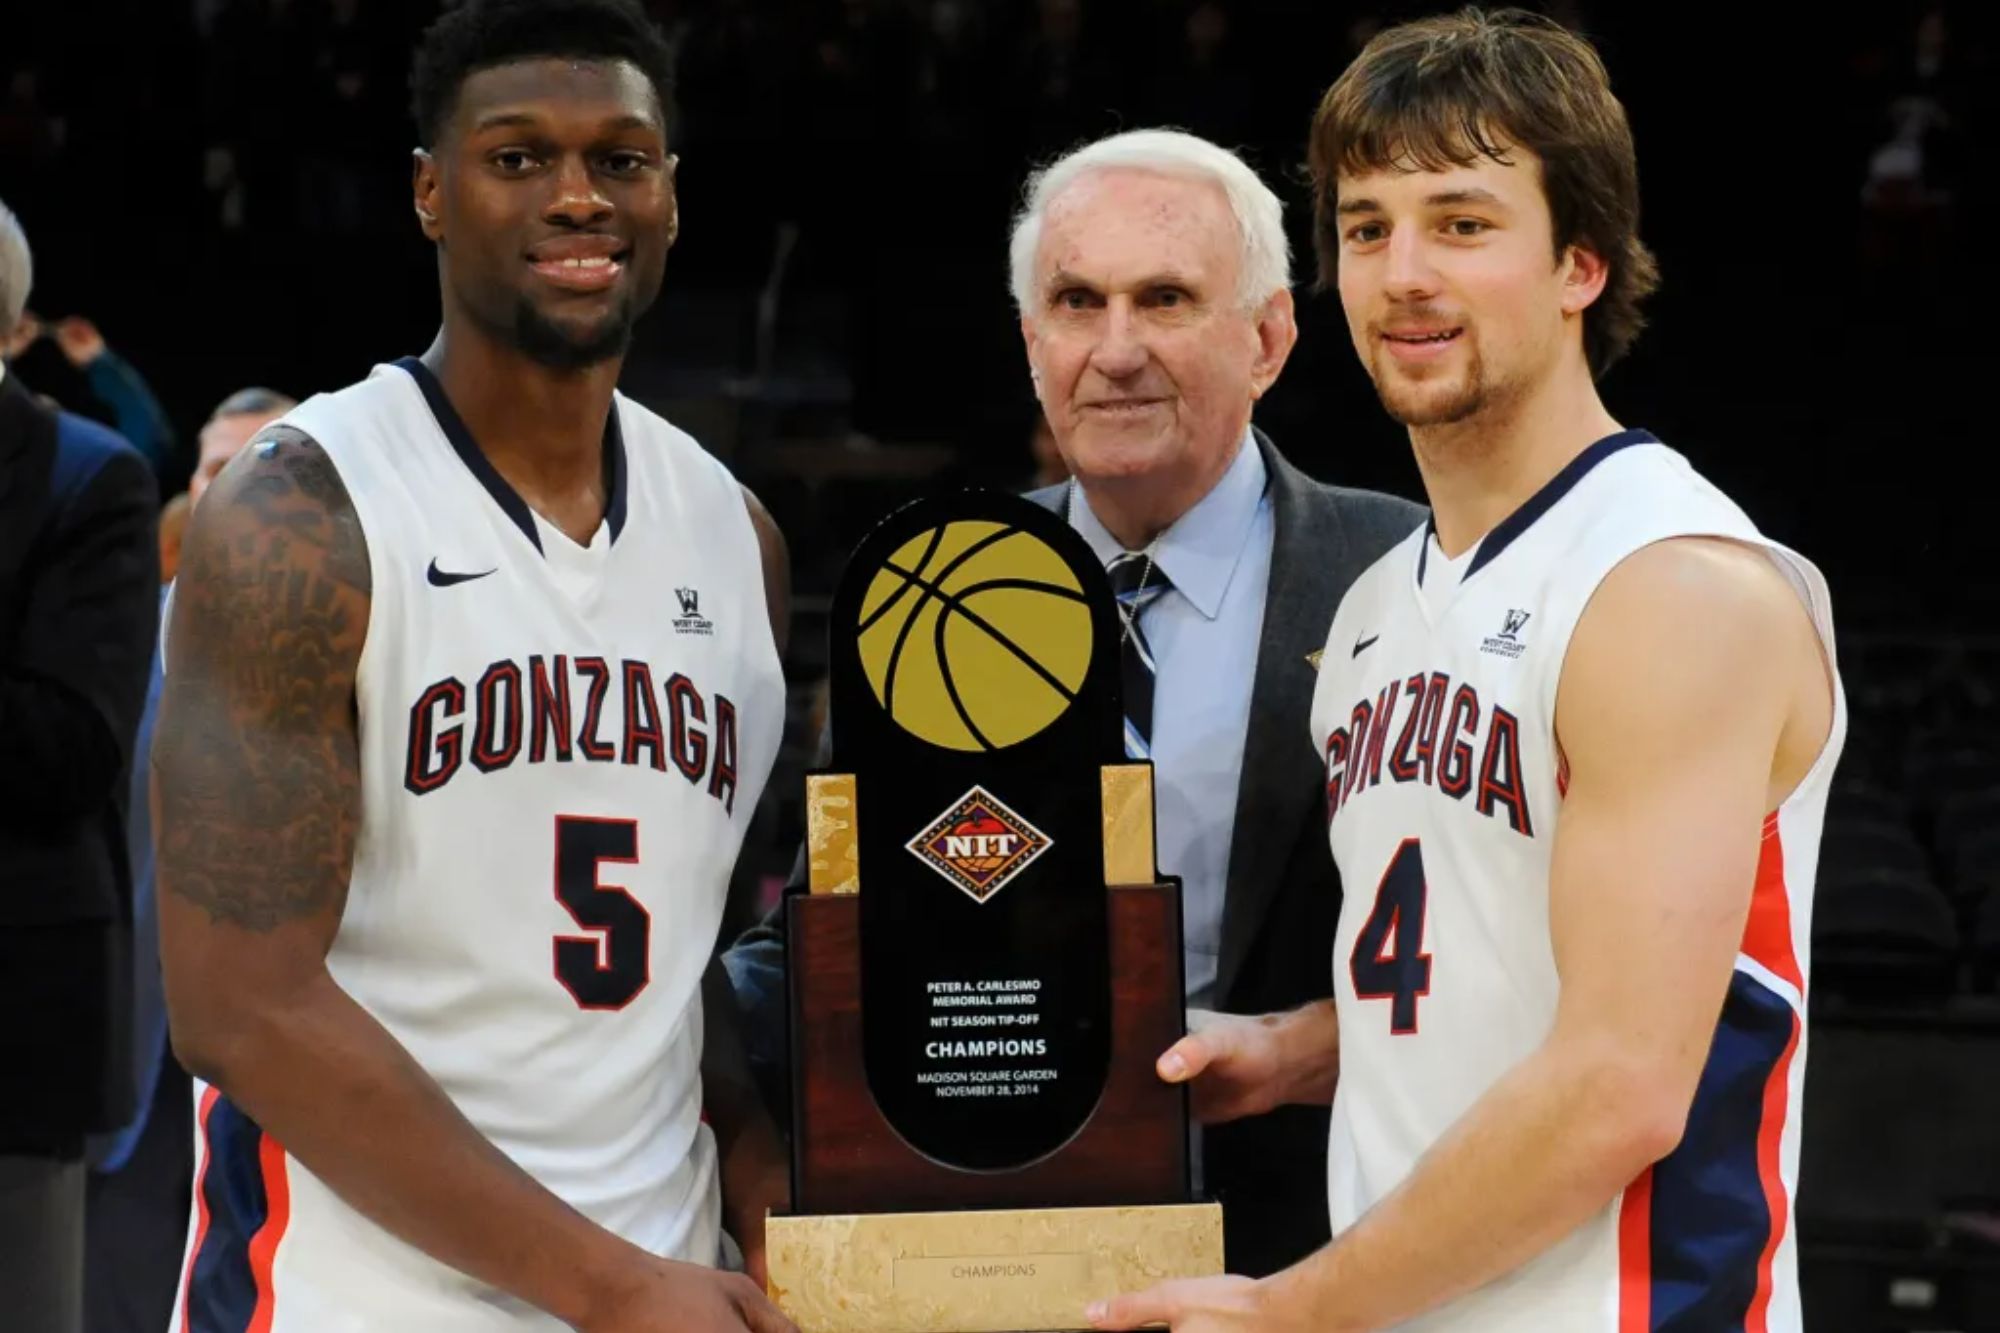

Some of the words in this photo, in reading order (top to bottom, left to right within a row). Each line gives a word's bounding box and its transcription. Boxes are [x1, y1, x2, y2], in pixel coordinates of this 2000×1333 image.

[404, 654, 738, 818] GONZAGA
[1326, 671, 1534, 838] GONZAGA
[944, 833, 1018, 859] NIT
[553, 814, 651, 1011] 5
[1350, 838, 1432, 1035] 4
[927, 982, 962, 993] PETER
[964, 981, 976, 992] A.
[976, 980, 1042, 992] CARLESIMO
[933, 996, 994, 1007] MEMORIAL
[995, 994, 1037, 1005] AWARD
[930, 1017, 949, 1028] NIT
[951, 1015, 997, 1027] SEASON
[997, 1014, 1040, 1025] TIP-OFF
[925, 1038, 1047, 1058] CHAMPIONS
[917, 1072, 968, 1083] MADISON
[969, 1070, 1011, 1083] SQUARE
[1013, 1069, 1058, 1081] GARDEN
[936, 1085, 995, 1097] NOVEMBER
[996, 1085, 1012, 1096] 28,
[1013, 1083, 1039, 1095] 2014
[952, 1264, 1037, 1278] CHAMPIONS
